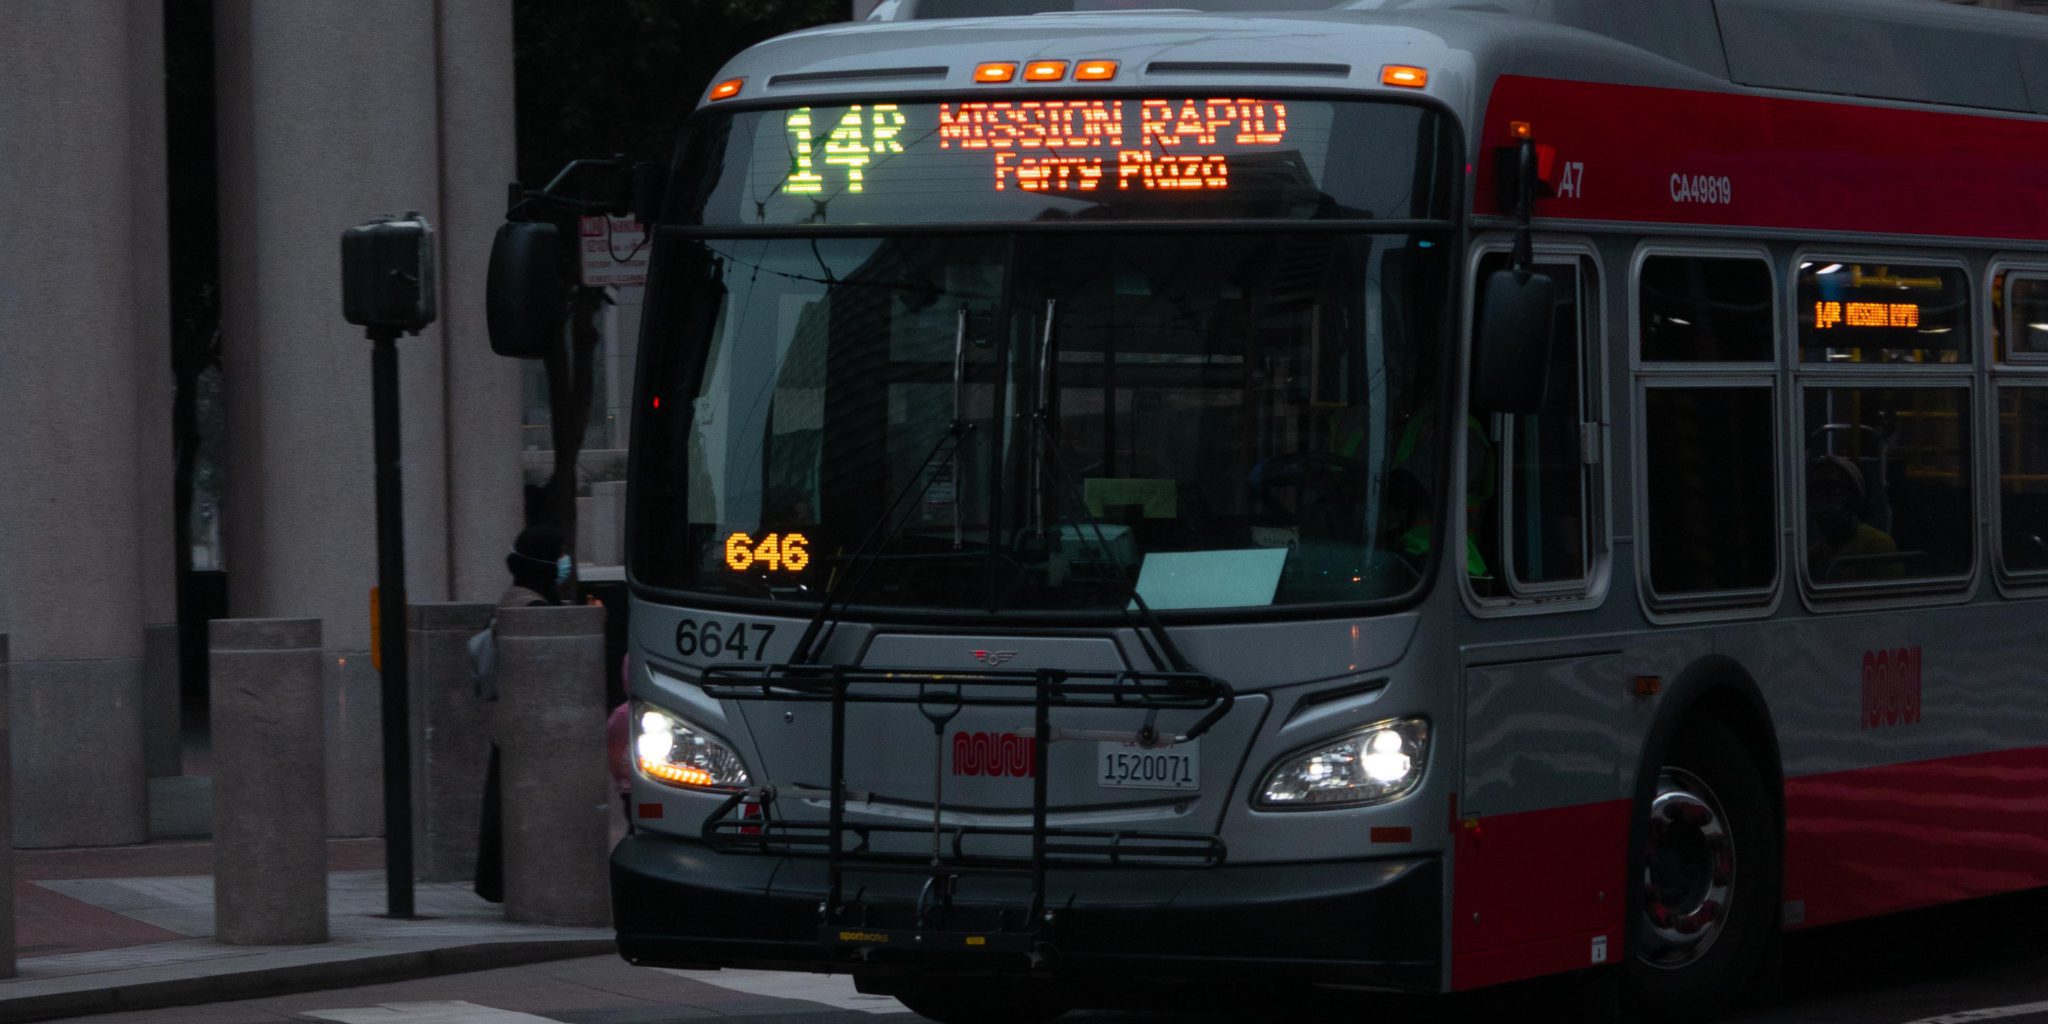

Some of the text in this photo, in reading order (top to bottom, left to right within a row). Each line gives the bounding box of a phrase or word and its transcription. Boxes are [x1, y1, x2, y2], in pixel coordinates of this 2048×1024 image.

[940, 101, 1122, 149] MISSION
[1142, 98, 1286, 145] RAPID
[995, 150, 1228, 190] Ferry Plaza
[1669, 172, 1732, 205] CA49819
[725, 531, 809, 571] 646
[676, 619, 776, 661] 6647
[1104, 754, 1193, 782] 1520071
